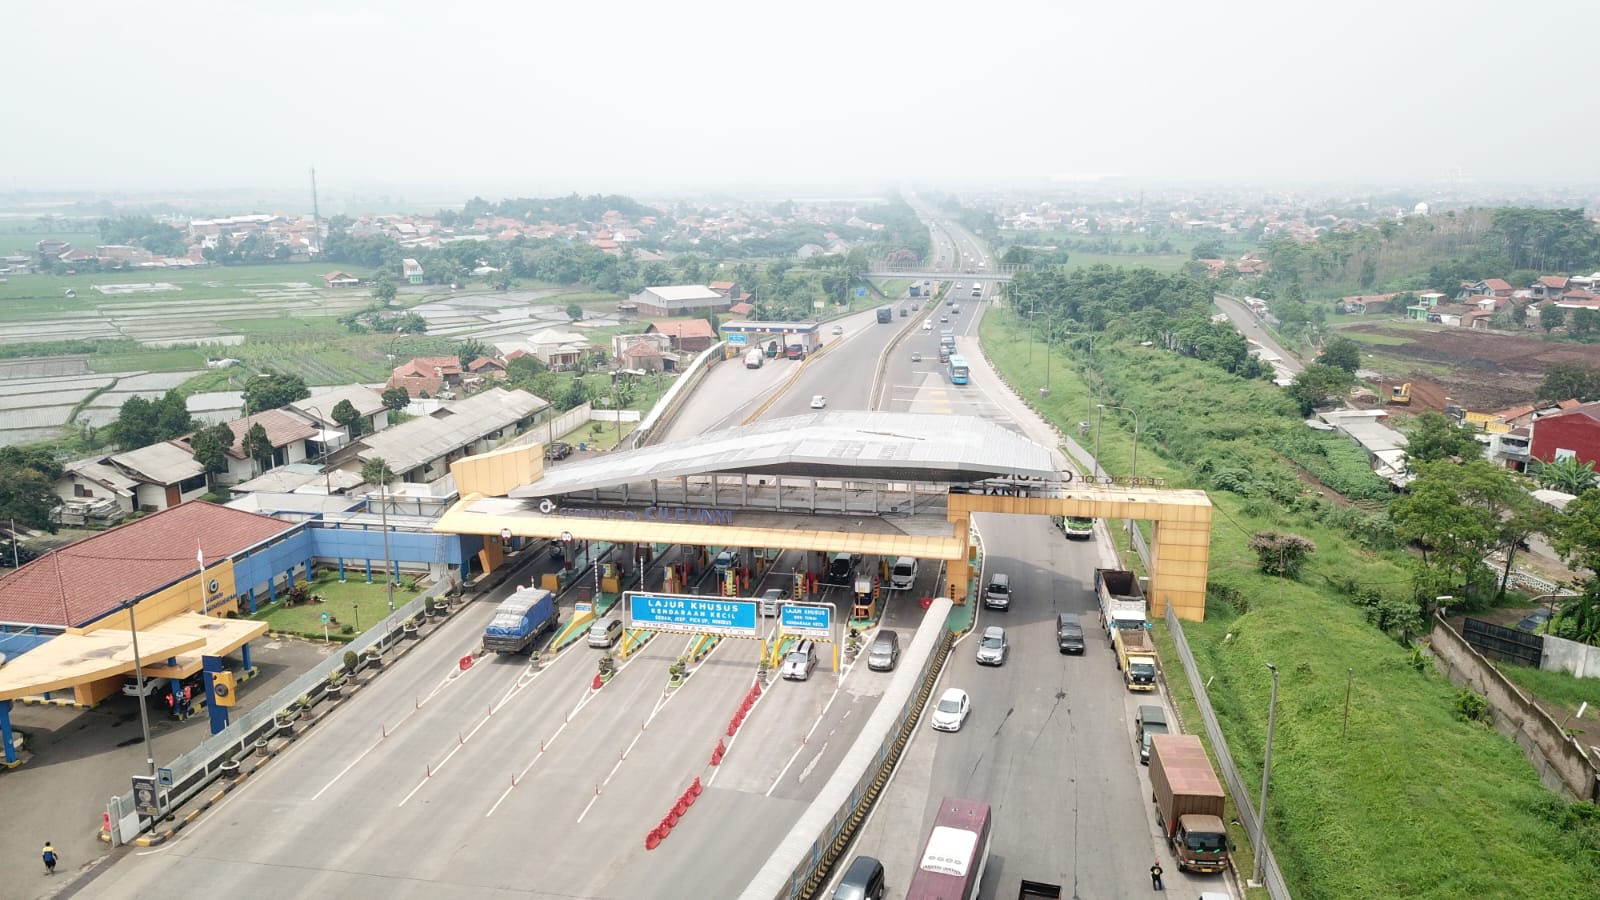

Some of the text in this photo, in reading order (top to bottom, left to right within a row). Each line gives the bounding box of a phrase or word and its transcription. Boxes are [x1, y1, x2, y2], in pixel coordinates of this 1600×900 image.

[645, 507, 733, 525] CILEUNYI
[648, 600, 739, 612] LAJUR KHUSUS
[651, 608, 706, 617] KENDARAAN
